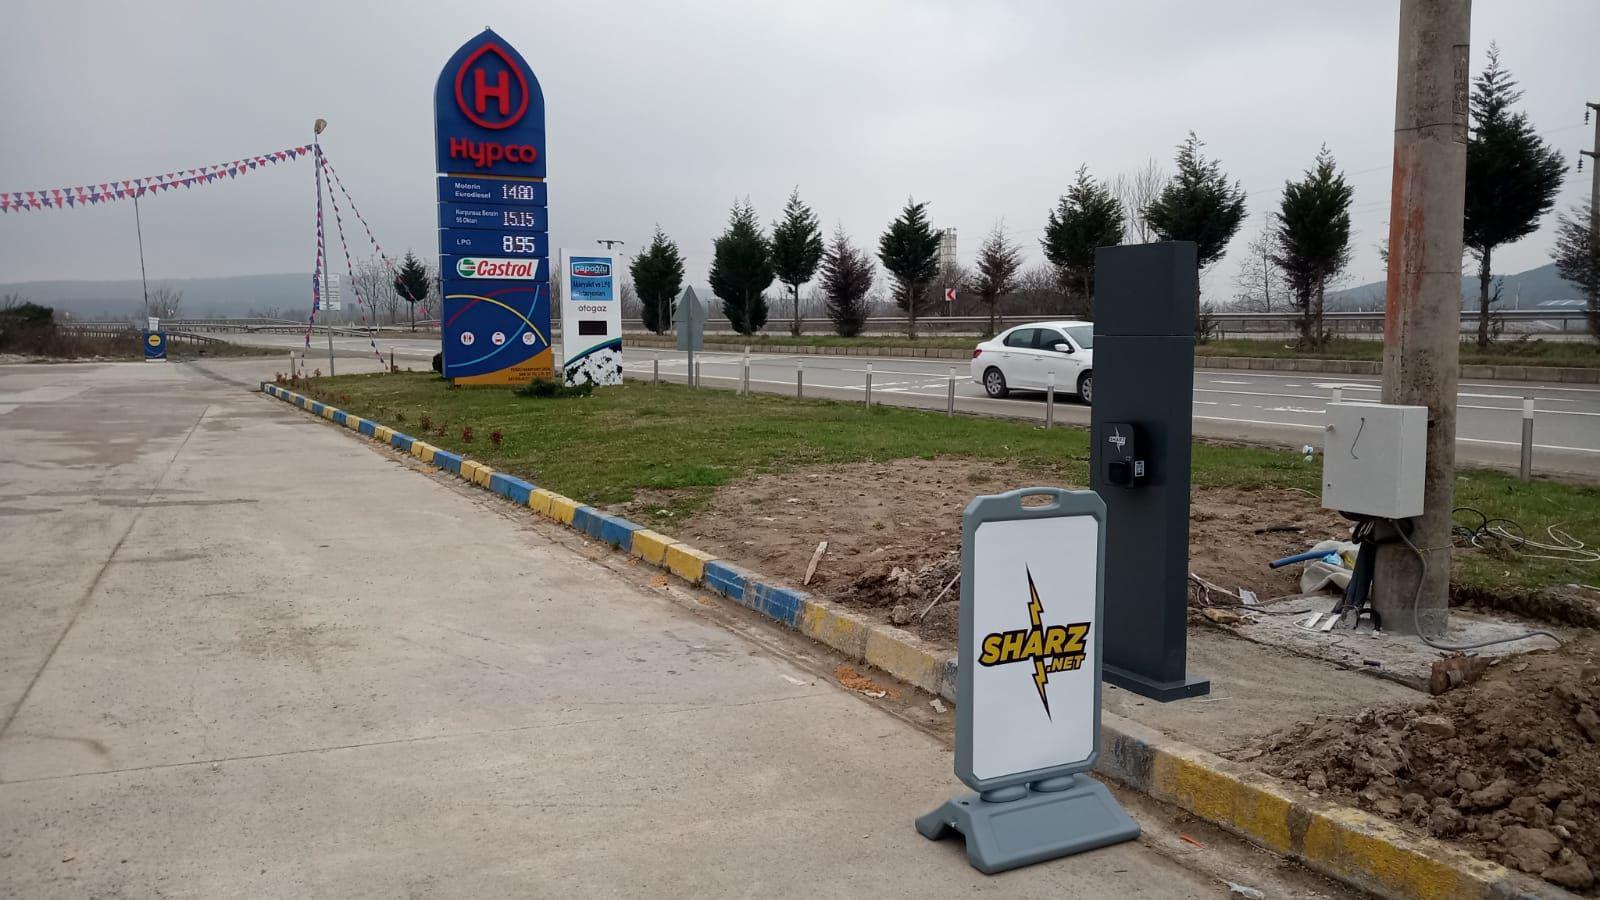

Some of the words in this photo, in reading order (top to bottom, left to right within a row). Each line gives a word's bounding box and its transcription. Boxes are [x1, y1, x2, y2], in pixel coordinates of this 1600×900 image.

[475, 68, 509, 115] H
[449, 136, 537, 168] Hypco
[503, 211, 535, 227] 15.15
[503, 236, 535, 253] 8.95
[477, 260, 533, 277] Castrol
[578, 305, 607, 313] otogaz
[978, 622, 1091, 667] SHARZ
